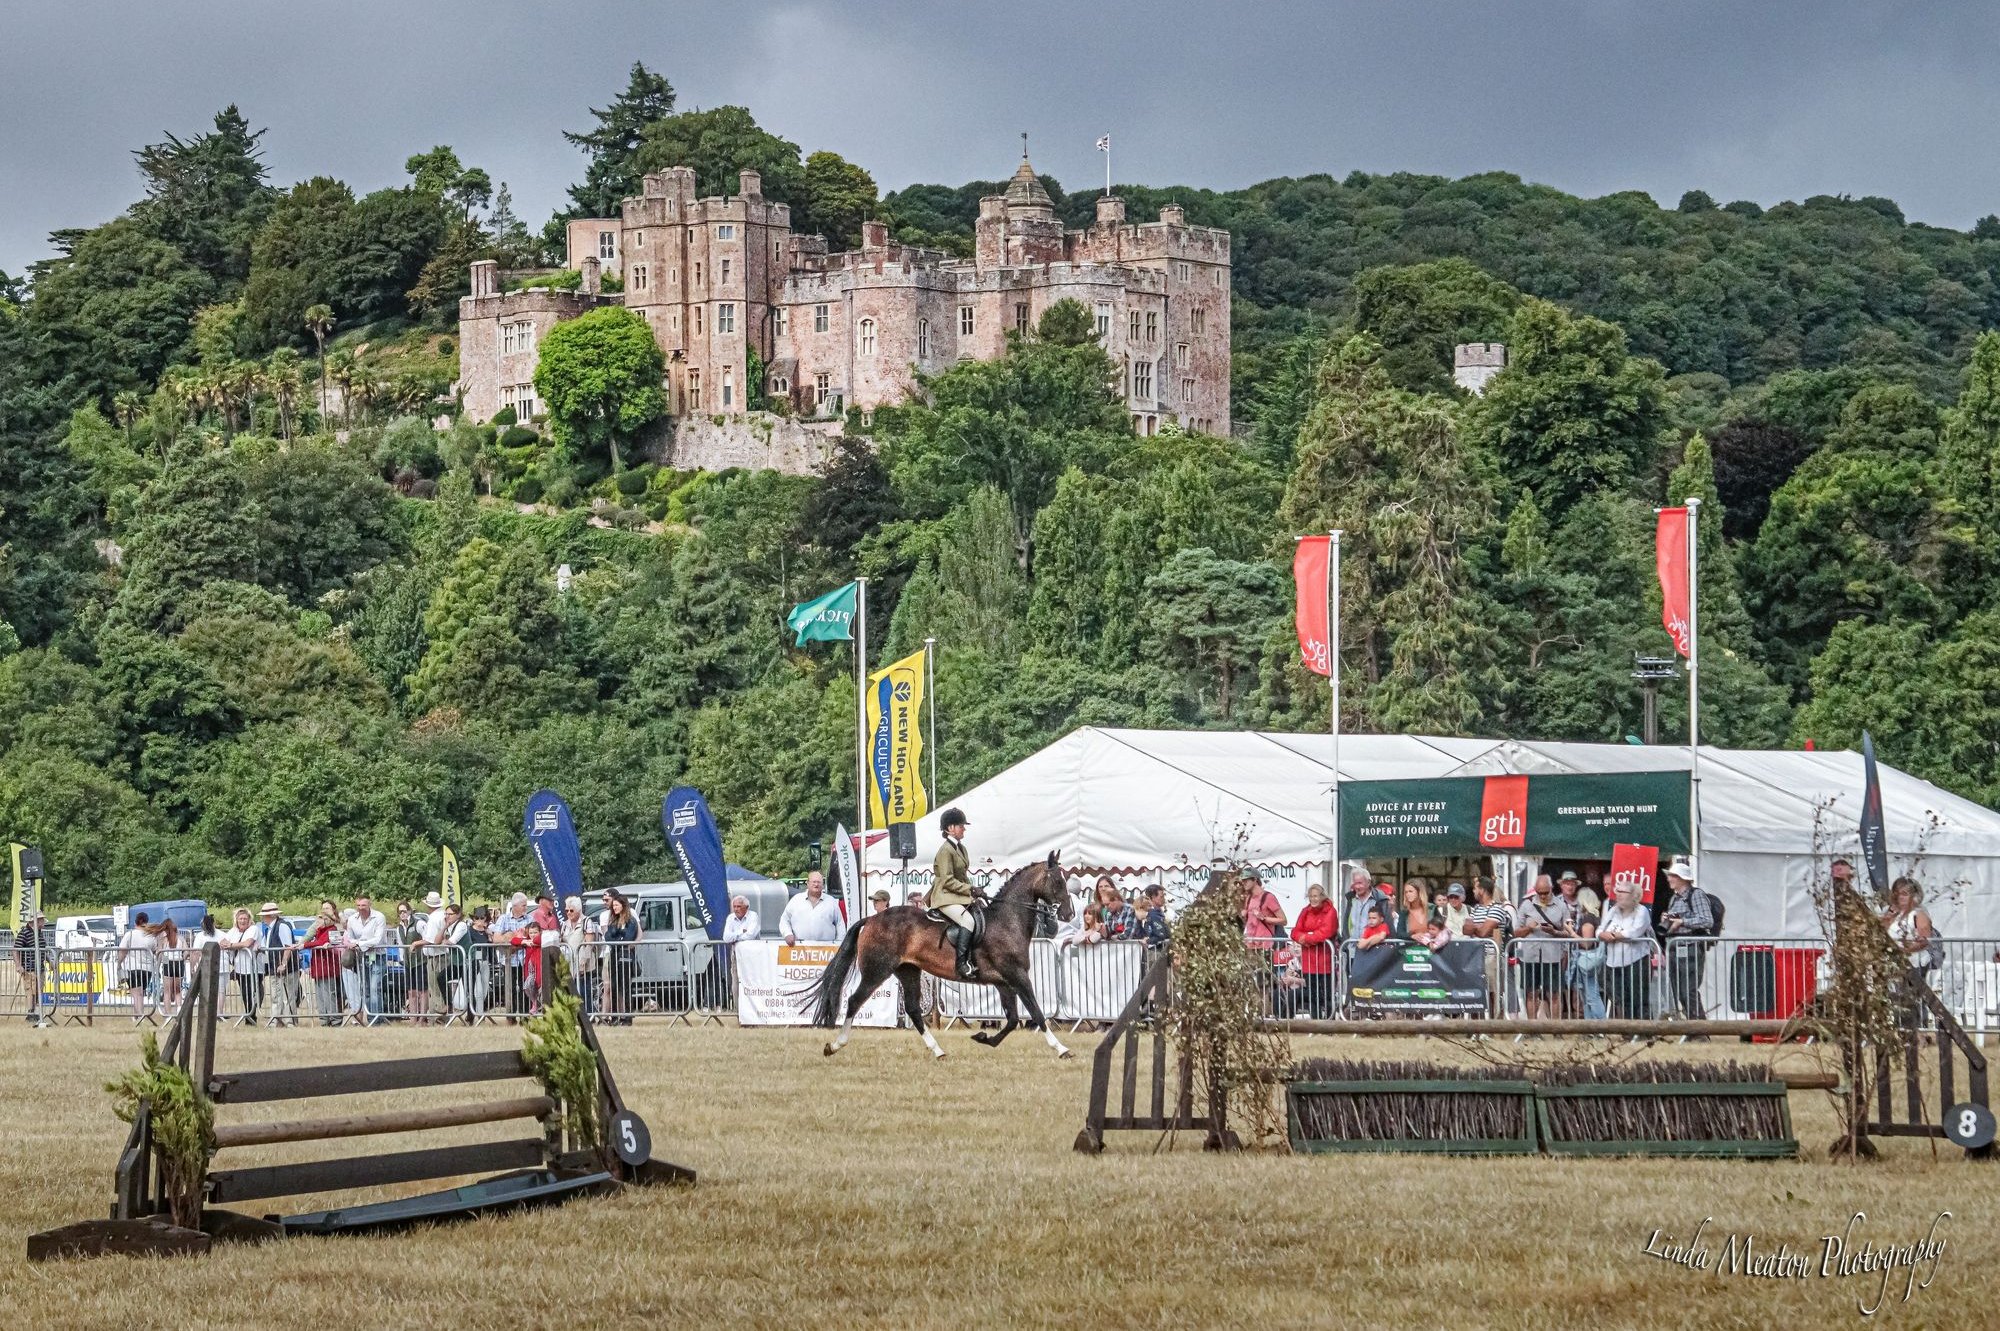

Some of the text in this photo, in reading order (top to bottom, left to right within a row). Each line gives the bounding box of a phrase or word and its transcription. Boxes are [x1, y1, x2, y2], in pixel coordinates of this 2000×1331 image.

[898, 706, 908, 743] NEW
[1365, 801, 1447, 812] ADVICE AT EVERY
[1557, 804, 1658, 815] GREENSLADE TAYLOR HUNT
[1369, 813, 1440, 824] STAGE OF YOUR
[1585, 817, 1631, 827] www.gth.net
[1360, 825, 1450, 837] PROPERTY JOURNEY
[1484, 809, 1521, 842] gth
[1189, 868, 1212, 881] PICKA
[533, 841, 566, 925] www.iwt.o.uk
[675, 840, 713, 925] www.iwt.co.uk
[790, 950, 836, 962] BATEMA
[784, 968, 823, 979] HOSEG
[743, 987, 773, 996] Chartered
[1958, 1109, 1977, 1138] 8
[621, 1120, 637, 1153] 5
